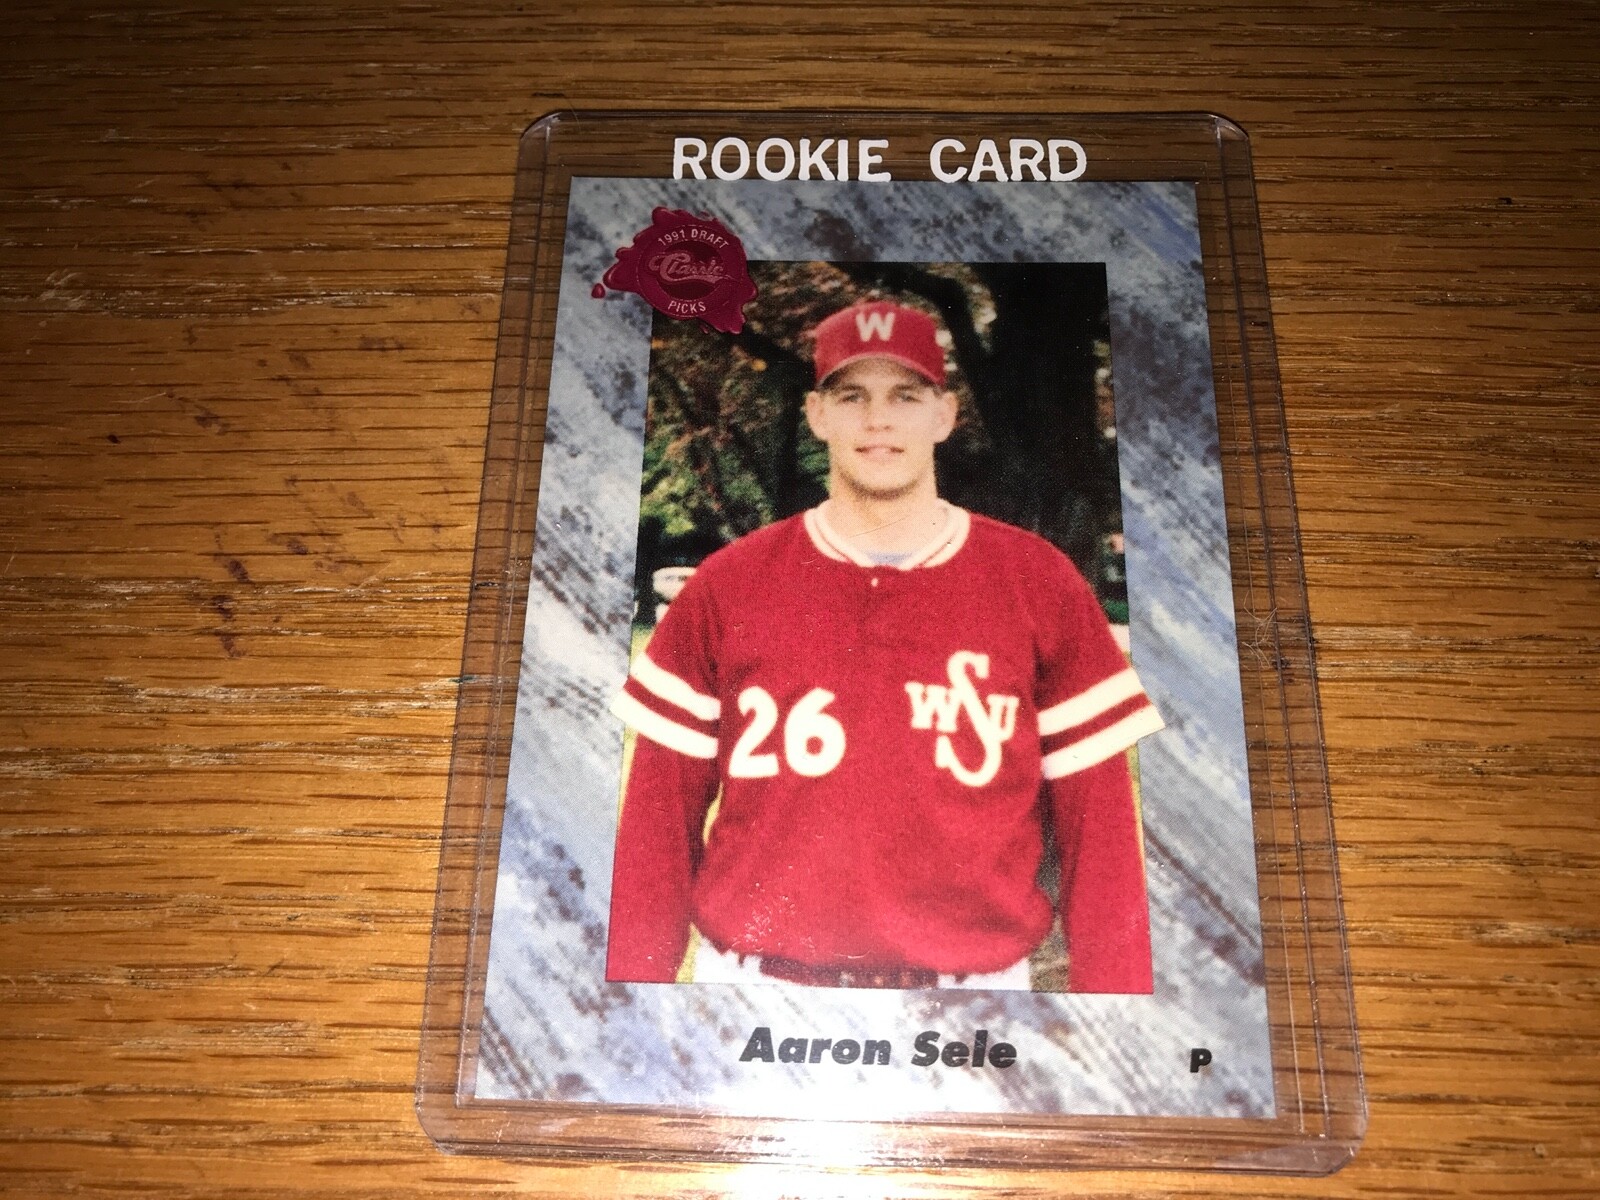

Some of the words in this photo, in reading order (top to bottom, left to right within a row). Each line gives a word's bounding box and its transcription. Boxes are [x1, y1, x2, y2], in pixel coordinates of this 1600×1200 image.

[672, 136, 892, 183] ROOKIE
[929, 138, 1088, 184] CARD
[657, 229, 686, 247] 1991
[690, 228, 730, 249] DRAFT
[667, 299, 707, 314] PICKS
[855, 311, 896, 342] W
[728, 685, 847, 778] 26
[738, 1026, 892, 1066] Aaron
[910, 1029, 1018, 1068] Sele
[1188, 1048, 1213, 1074] P
